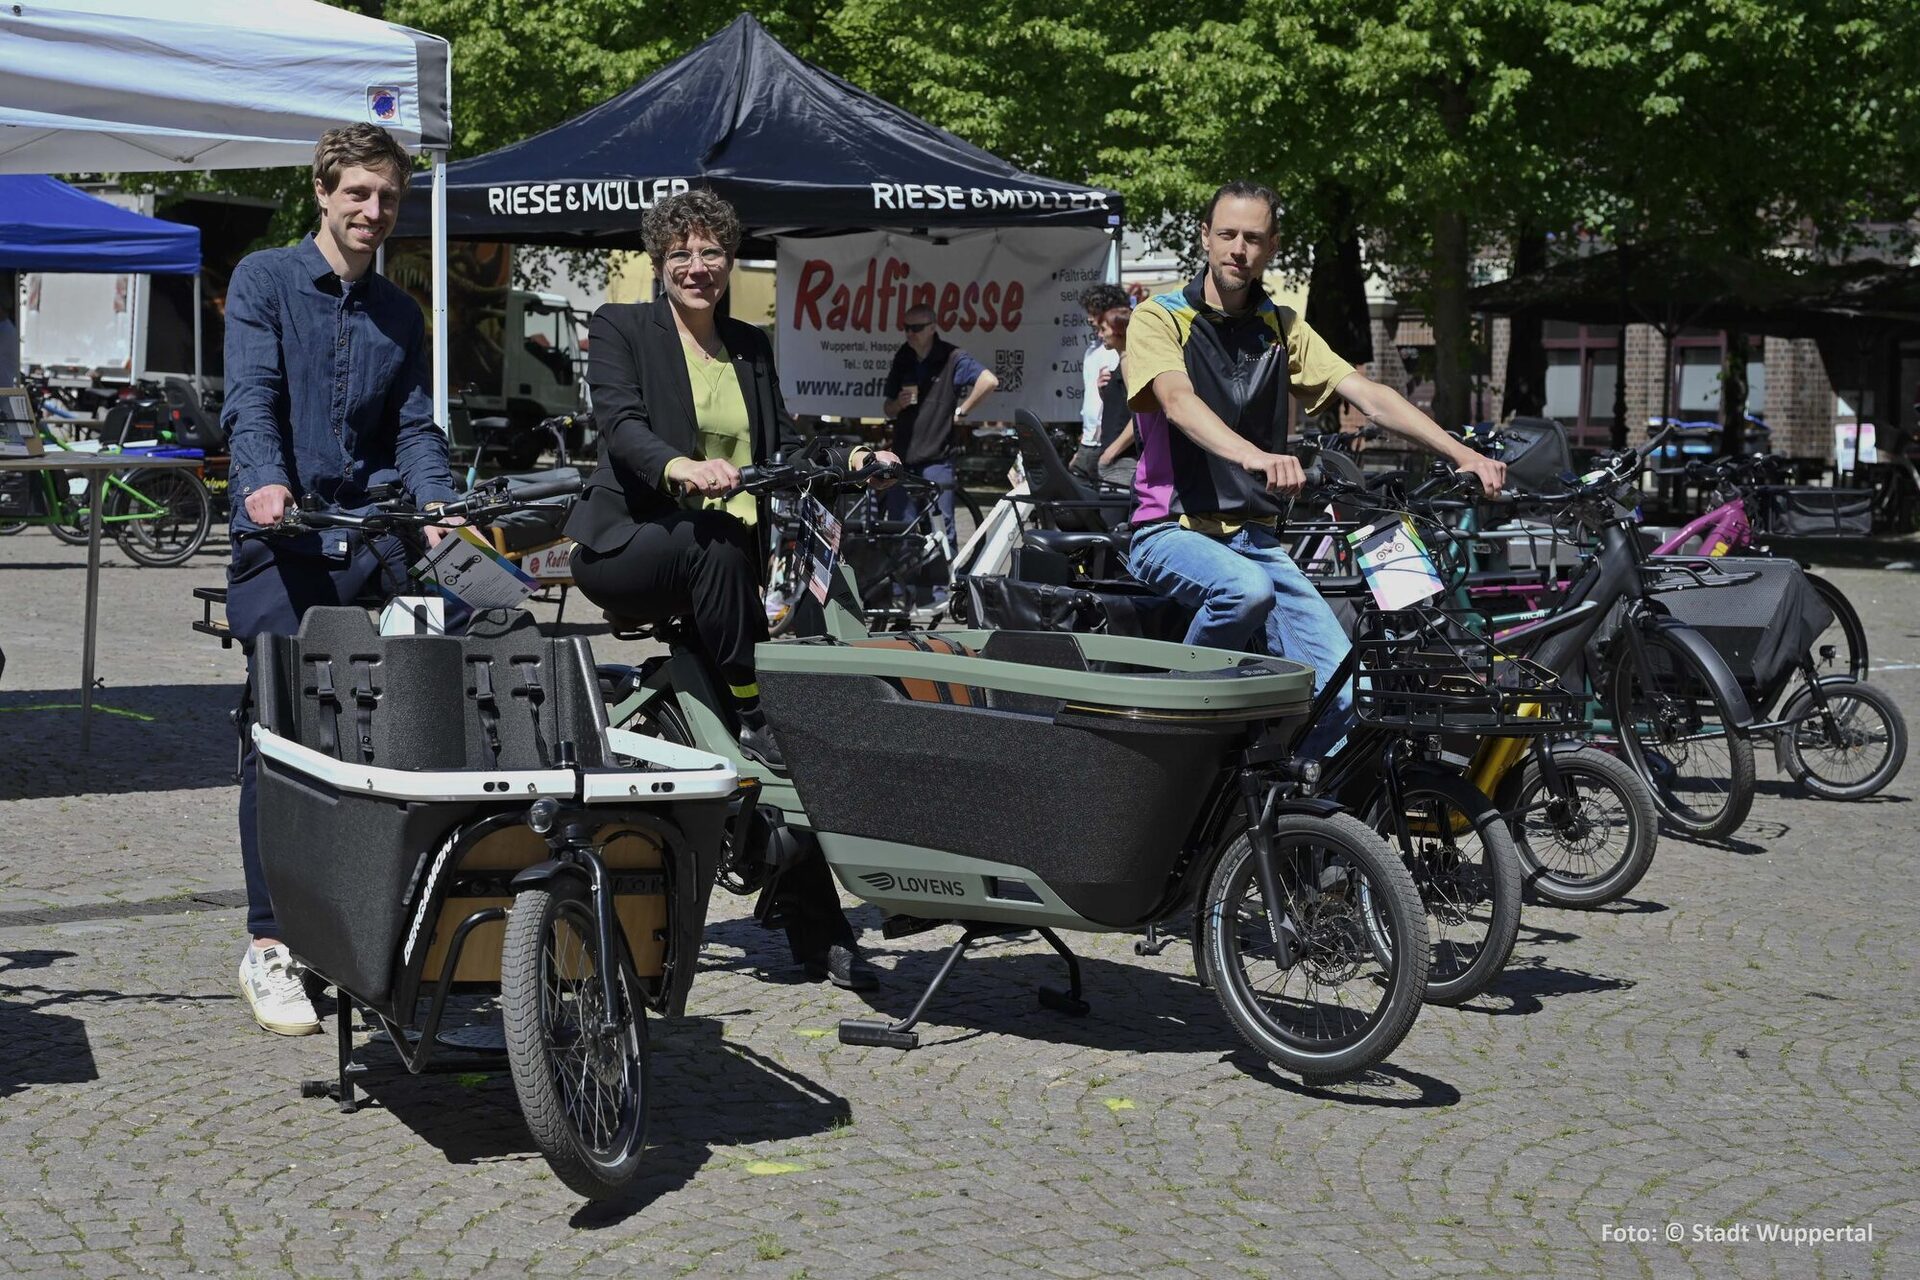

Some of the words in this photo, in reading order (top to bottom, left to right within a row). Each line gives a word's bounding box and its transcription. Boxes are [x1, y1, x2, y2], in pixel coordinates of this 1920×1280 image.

[1059, 268, 1102, 282] Falträder
[793, 256, 1025, 334] Radfinesse
[1060, 288, 1079, 302] seit
[1061, 335, 1079, 347] seit
[863, 359, 874, 370] 02
[897, 876, 965, 897] LOVENS
